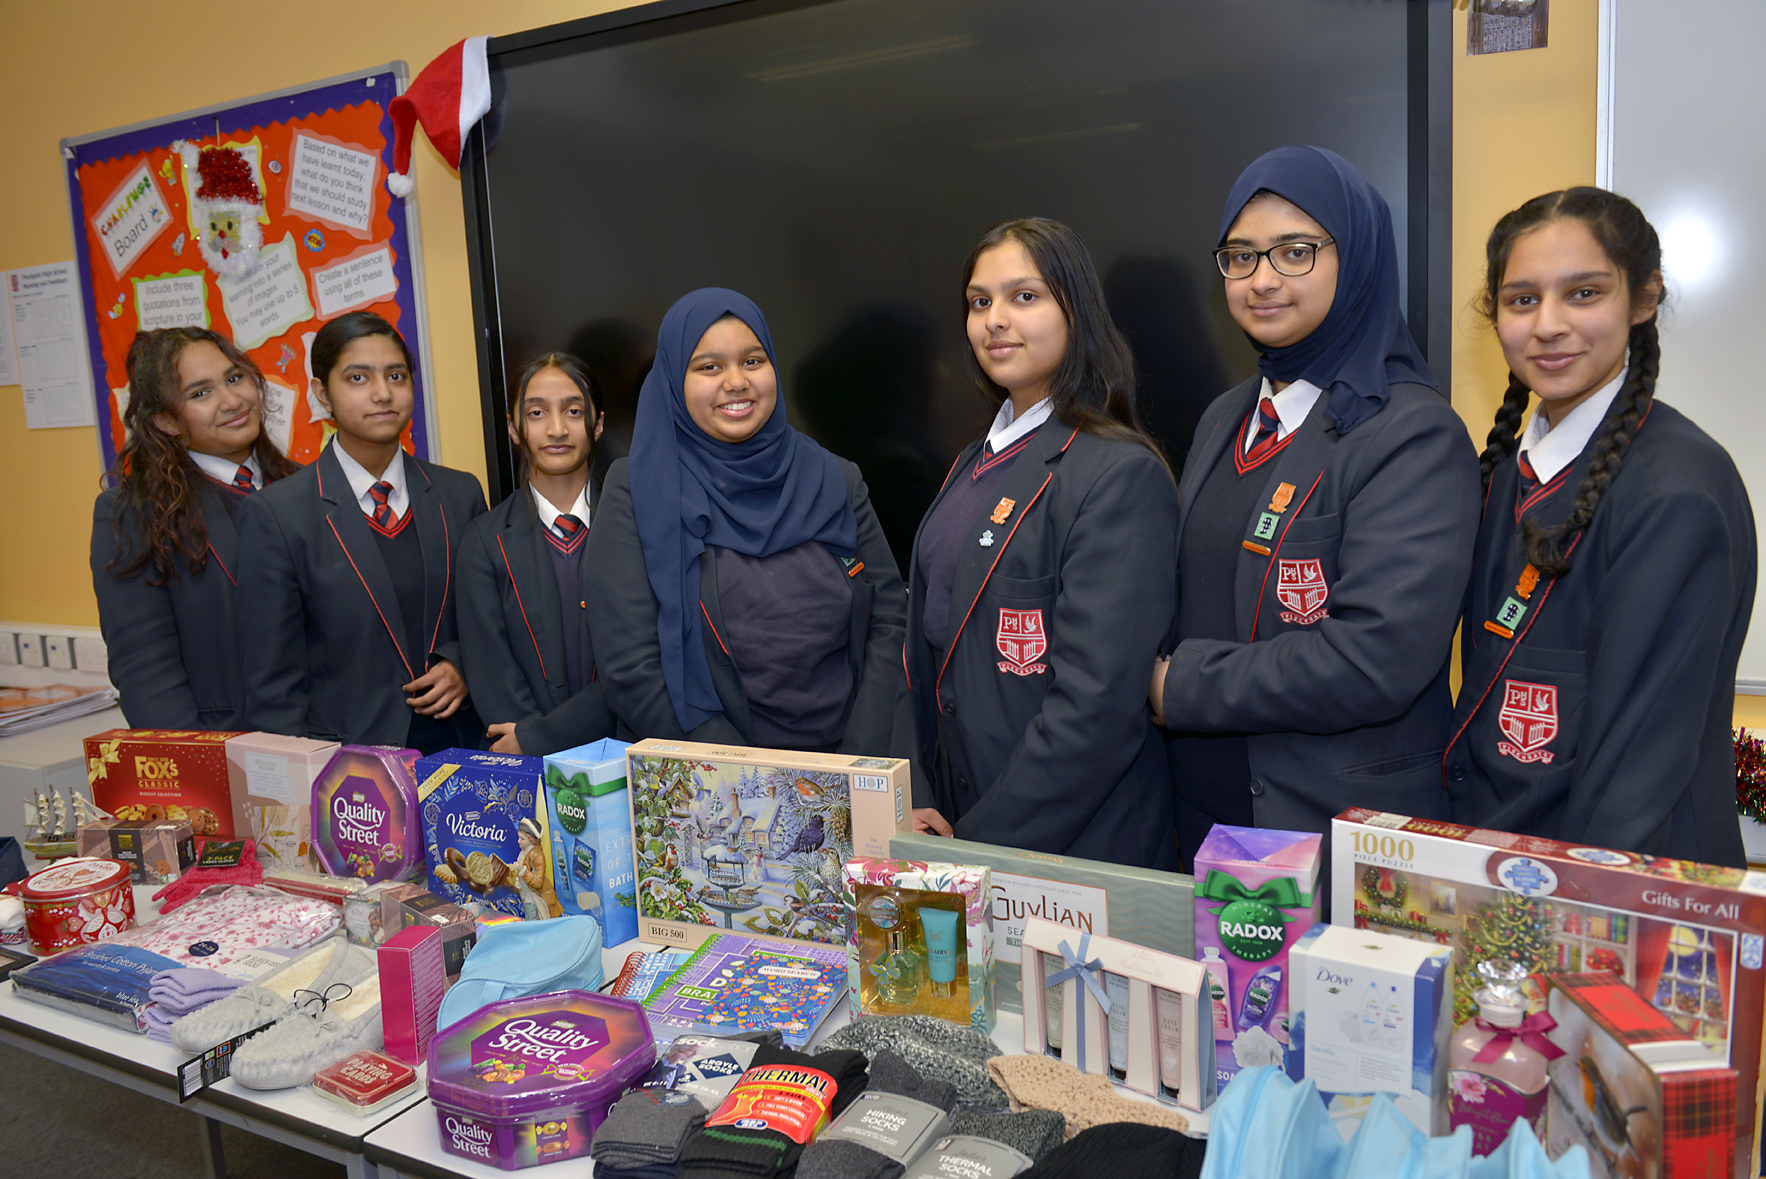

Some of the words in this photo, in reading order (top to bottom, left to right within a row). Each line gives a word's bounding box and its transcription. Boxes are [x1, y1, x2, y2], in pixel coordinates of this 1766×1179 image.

[302, 153, 319, 166] have
[321, 158, 342, 173] learnt
[303, 139, 325, 154] Based
[326, 148, 336, 157] on
[338, 151, 356, 164] what
[358, 157, 369, 167] we
[301, 168, 318, 180] what
[319, 173, 329, 183] do
[330, 176, 344, 188] you
[346, 180, 364, 194] think
[294, 178, 308, 190] that
[309, 184, 320, 194] we
[321, 188, 346, 202] should
[346, 196, 367, 211] study
[291, 192, 306, 204] next
[307, 196, 330, 211] lesson
[332, 204, 346, 217] and
[348, 211, 368, 224] why?
[114, 213, 148, 257] Board
[318, 270, 342, 284] Create
[343, 267, 348, 275] a
[350, 255, 383, 272] sentence
[145, 283, 172, 294] Include
[173, 281, 194, 292] three
[228, 284, 253, 304] learning
[254, 276, 266, 288] into
[266, 273, 271, 281] a
[272, 262, 292, 277] series
[324, 283, 342, 296] using
[344, 278, 352, 289] all
[354, 274, 360, 286] of
[362, 270, 382, 282] these
[142, 298, 180, 312] quotations
[182, 295, 200, 306] from
[235, 316, 248, 326] You
[249, 306, 262, 320] may
[263, 300, 275, 311] use
[276, 294, 286, 304] up
[286, 289, 294, 298] to
[293, 284, 299, 294] 5
[247, 295, 253, 306] of
[143, 314, 174, 326] scripture
[176, 312, 183, 322] in
[185, 312, 202, 324] your
[138, 780, 180, 788] CLASSIC
[334, 797, 386, 830] Quality
[558, 803, 586, 820] RADOX
[338, 820, 380, 846] Street
[446, 814, 506, 842] Victoria
[1350, 830, 1415, 862] 1000
[608, 857, 620, 870] OF
[1354, 854, 1380, 863] PIECE
[1382, 859, 1415, 870] PUZZLE
[609, 871, 634, 889] BATH
[1232, 902, 1273, 916] MINERAL
[1642, 890, 1680, 908] Gifts
[1684, 896, 1712, 914] For
[1714, 903, 1740, 920] All
[651, 926, 668, 936] BIG
[670, 928, 684, 940] 500
[1220, 921, 1284, 941] RADOX
[1232, 945, 1272, 959] THERAPY
[110, 956, 138, 970] Cotton
[1316, 966, 1354, 987] Dove
[505, 1020, 599, 1050] Quality
[488, 1033, 568, 1064] Street
[346, 1058, 392, 1080] PLAYING
[698, 1064, 734, 1075] SOCKS
[700, 1058, 740, 1071] ARGYLE
[340, 1067, 377, 1084] CARDS
[742, 1070, 828, 1098] THERMAL
[786, 1092, 806, 1101] PAIRS
[804, 1086, 824, 1100] SOCKS
[860, 1115, 900, 1132] SOCKS
[866, 1109, 907, 1126] HIKING
[446, 1117, 492, 1146] Quality
[451, 1134, 492, 1159] Street
[939, 1154, 992, 1177] THERMAL
[939, 1162, 981, 1179] SOCKS
